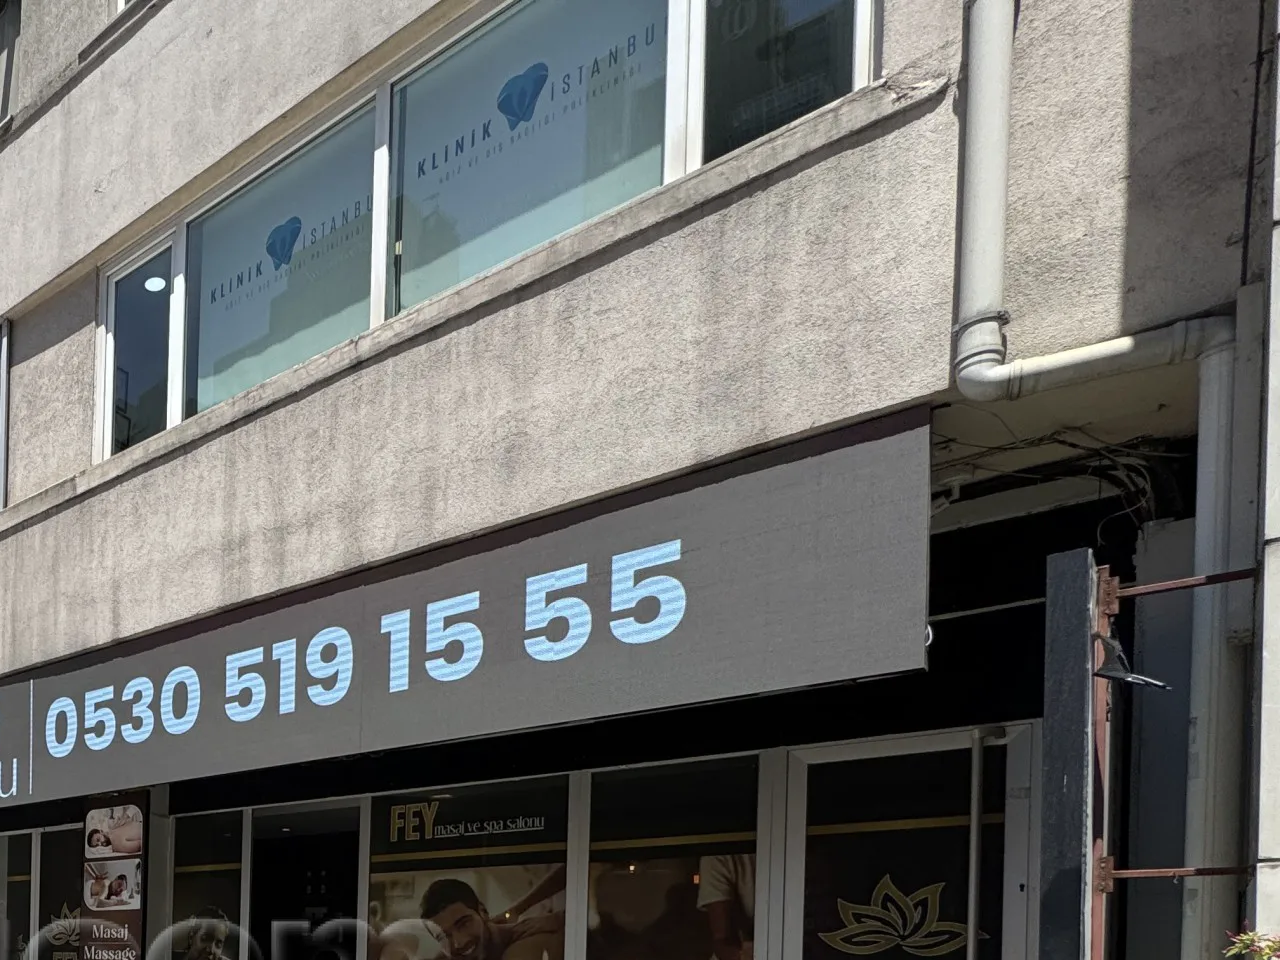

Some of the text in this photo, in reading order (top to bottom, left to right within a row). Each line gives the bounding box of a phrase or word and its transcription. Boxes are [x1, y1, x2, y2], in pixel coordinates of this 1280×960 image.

[45, 539, 687, 758] 0530 519 15 55
[390, 801, 545, 842] FEY masaj ve spa salonu
[92, 924, 129, 941] Masaj
